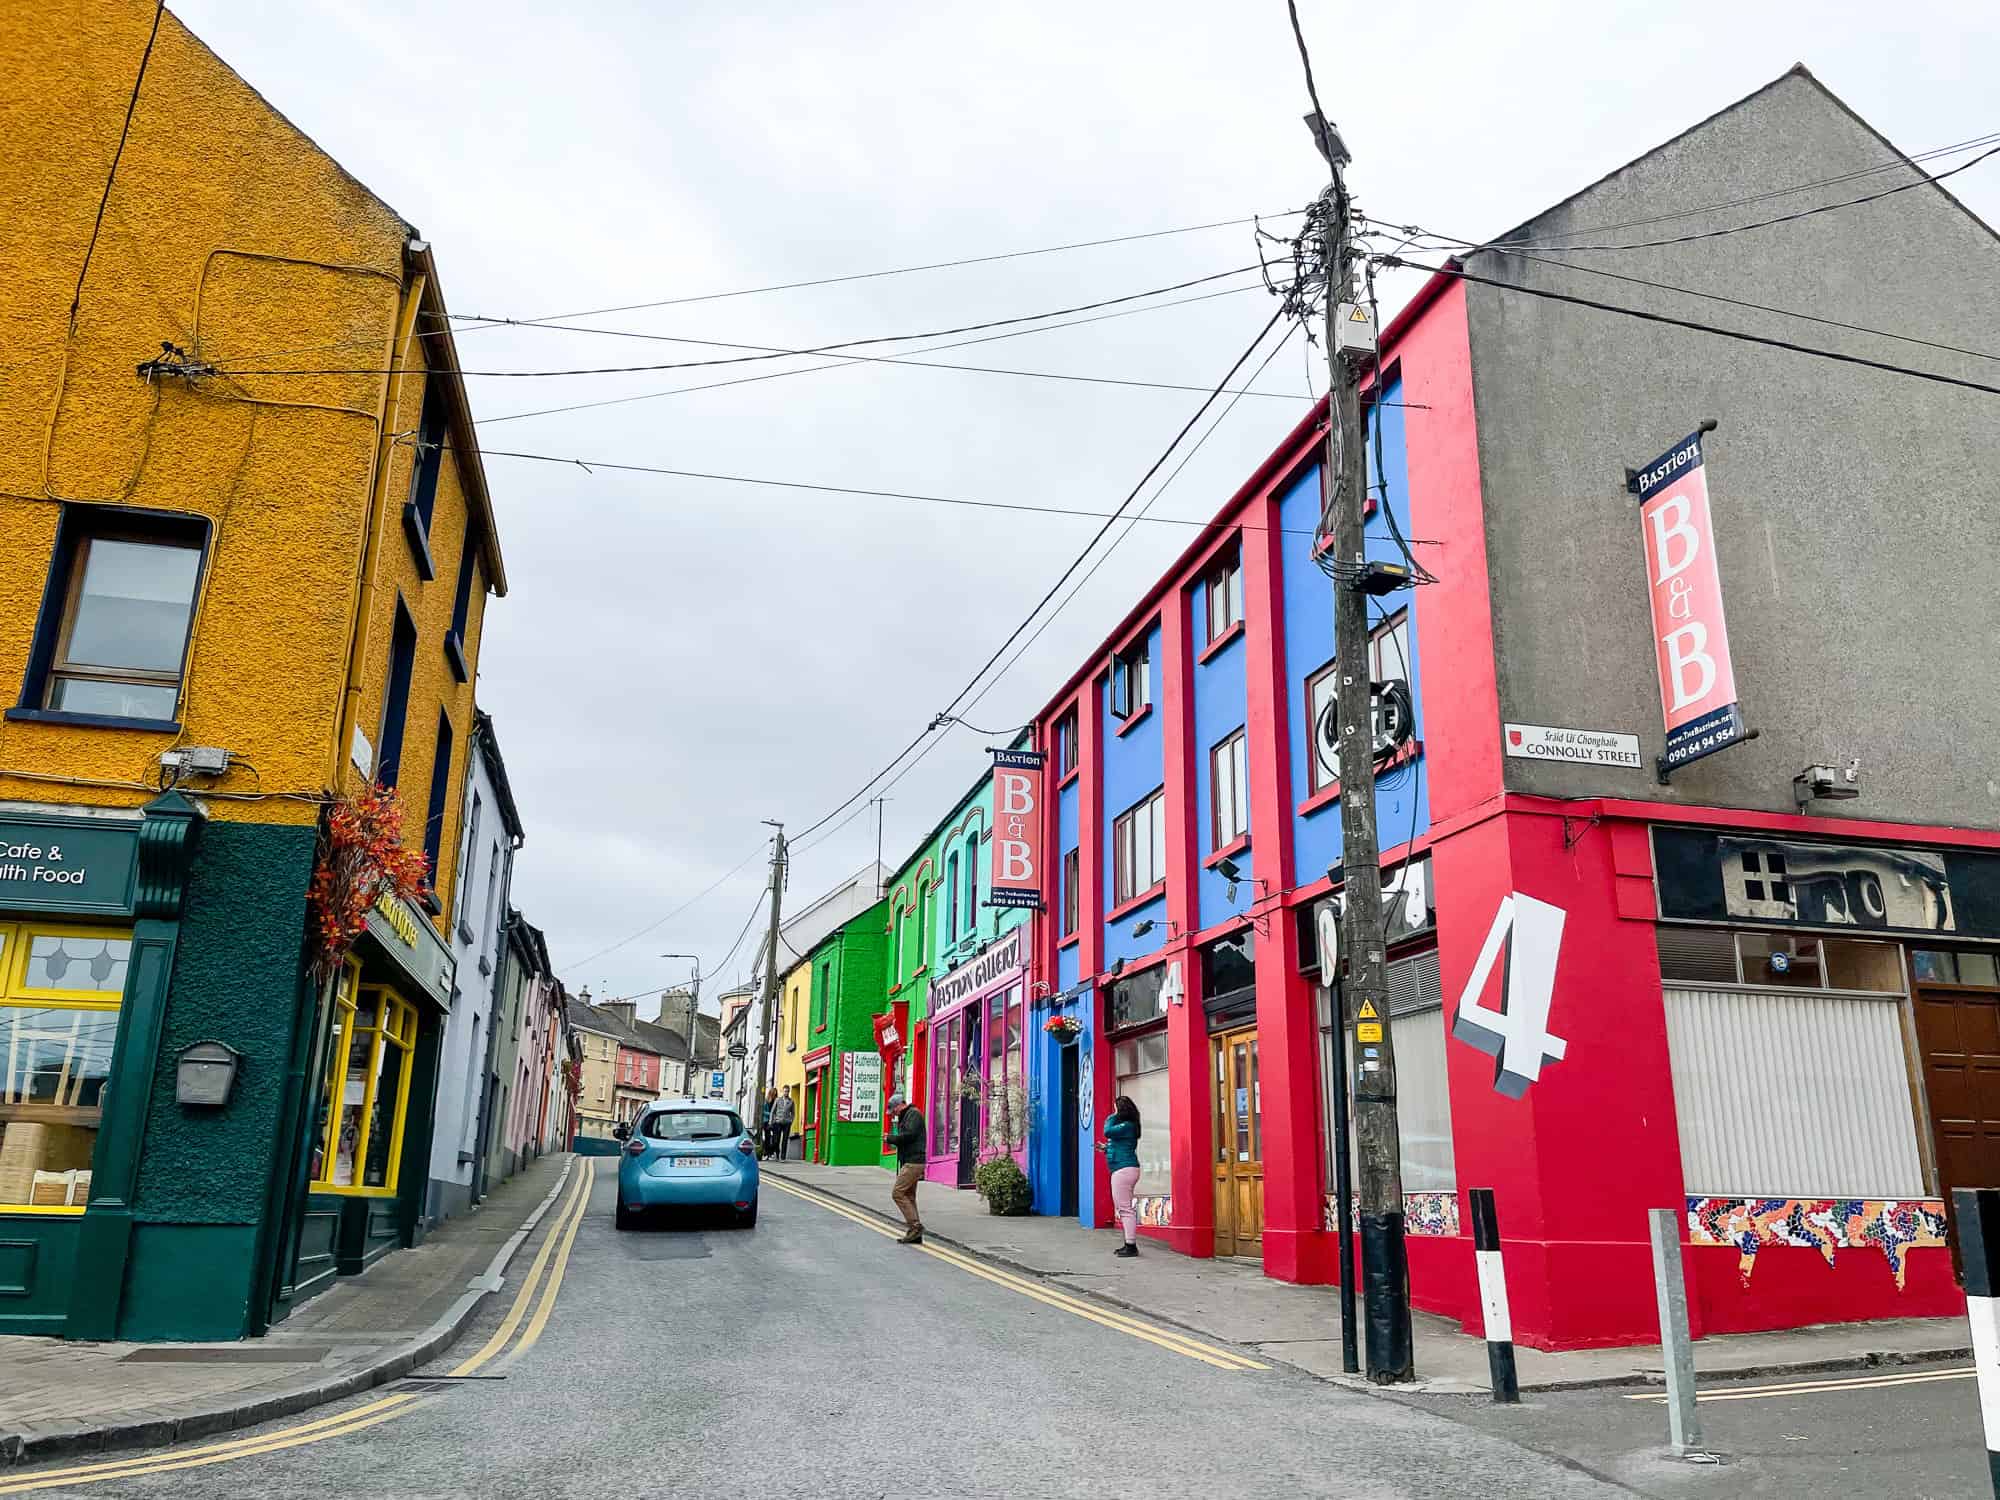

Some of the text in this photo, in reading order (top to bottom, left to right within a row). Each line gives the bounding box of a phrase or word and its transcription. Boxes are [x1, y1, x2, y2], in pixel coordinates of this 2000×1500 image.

[1648, 495, 1700, 586] B
[1669, 576, 1693, 619] &
[1662, 621, 1716, 714] B
[1526, 743, 1639, 764] CONNOLLY STREET
[1668, 726, 1735, 763] 090 64 94 954
[1000, 774, 1034, 815] B
[47, 845, 64, 860] &
[997, 839, 1033, 881] B
[0, 863, 85, 884] lth Food
[935, 938, 1018, 1009] BASTION GALLERY
